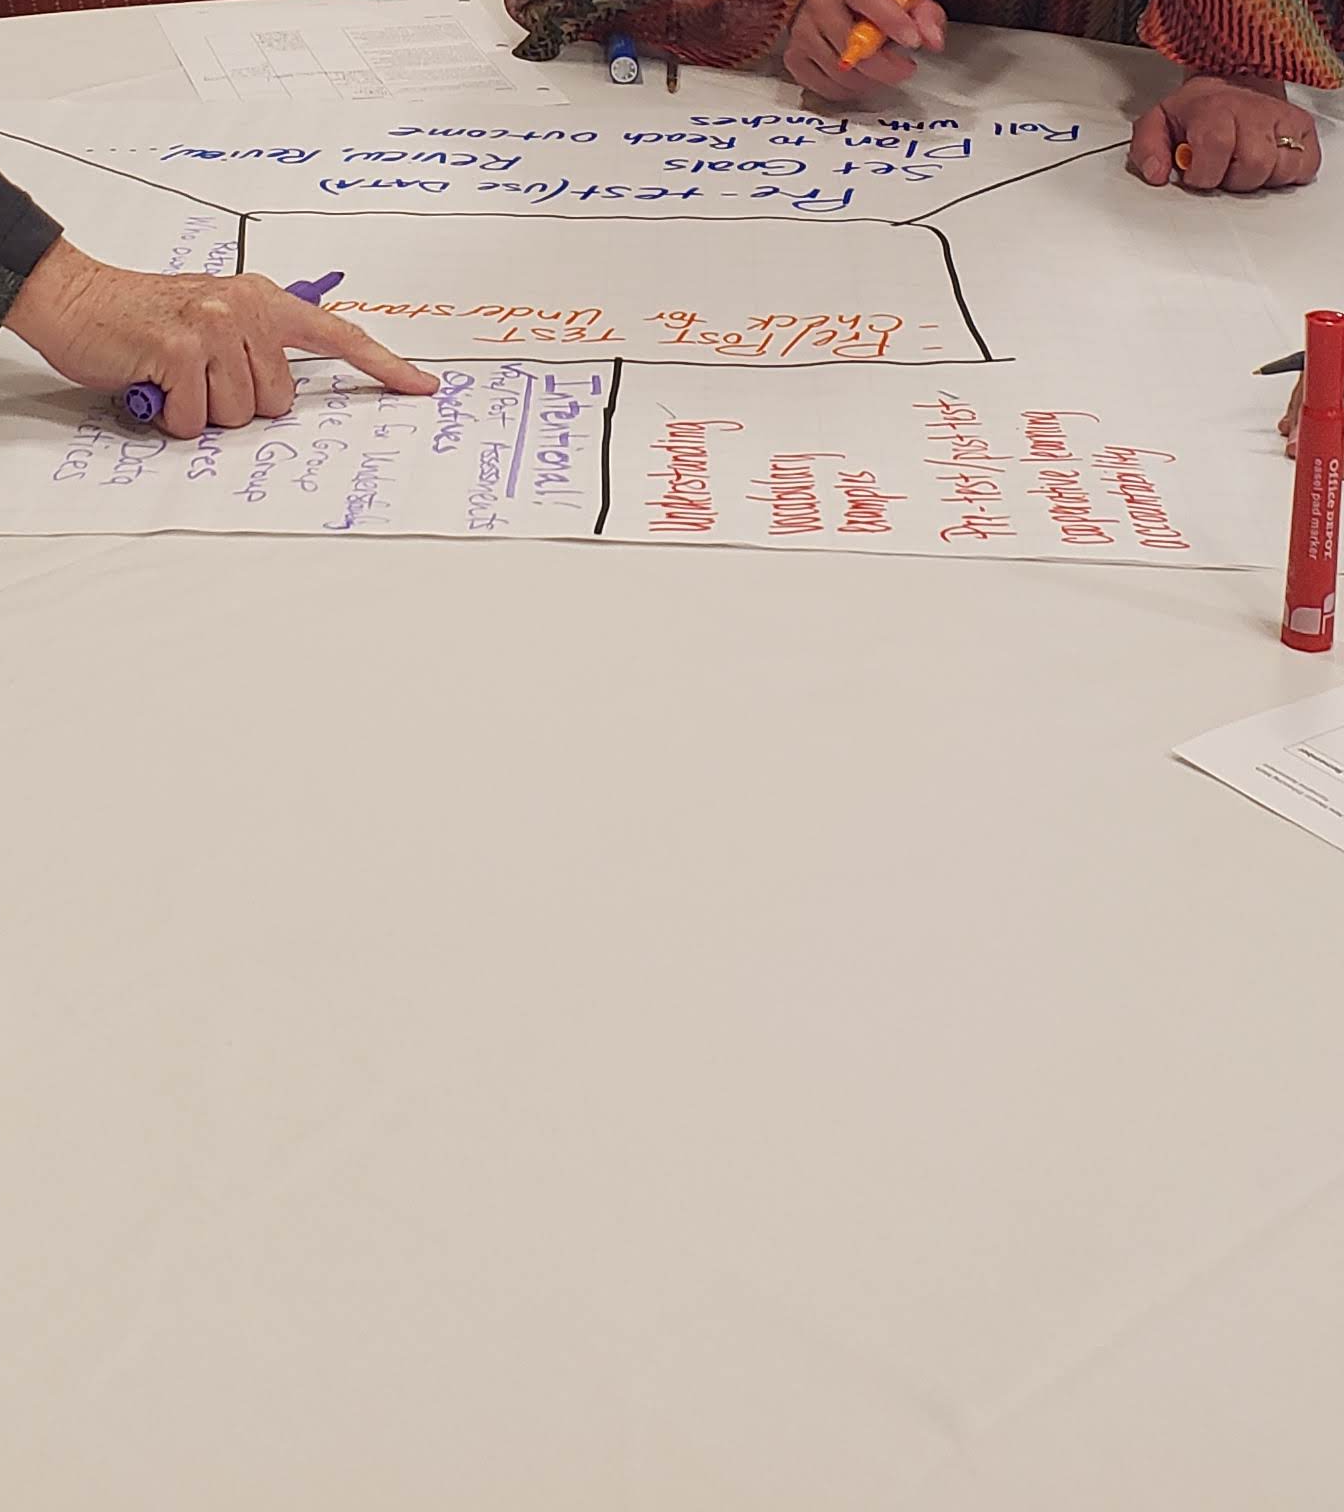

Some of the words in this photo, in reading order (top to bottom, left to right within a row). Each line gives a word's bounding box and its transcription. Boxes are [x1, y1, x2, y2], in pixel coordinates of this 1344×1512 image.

[689, 114, 849, 136] Punches
[878, 117, 960, 131] with
[993, 120, 1080, 143] Roll
[623, 131, 737, 150] Reach
[768, 134, 816, 145] to
[845, 136, 972, 160] Plan
[663, 157, 808, 177] Goals
[833, 159, 944, 182] Set
[642, 310, 708, 328] for
[748, 313, 904, 334] Check
[473, 325, 627, 344] TEST
[1019, 411, 1100, 463] learning
[100, 439, 167, 485] Data
[233, 441, 298, 502] Group
[292, 438, 348, 493] Group
[644, 420, 744, 532] Understanding
[1312, 458, 1323, 491] easel
[1327, 458, 1339, 508] Office
[834, 470, 908, 533] examples
[1311, 492, 1322, 516] pad
[1308, 517, 1320, 560] marker
